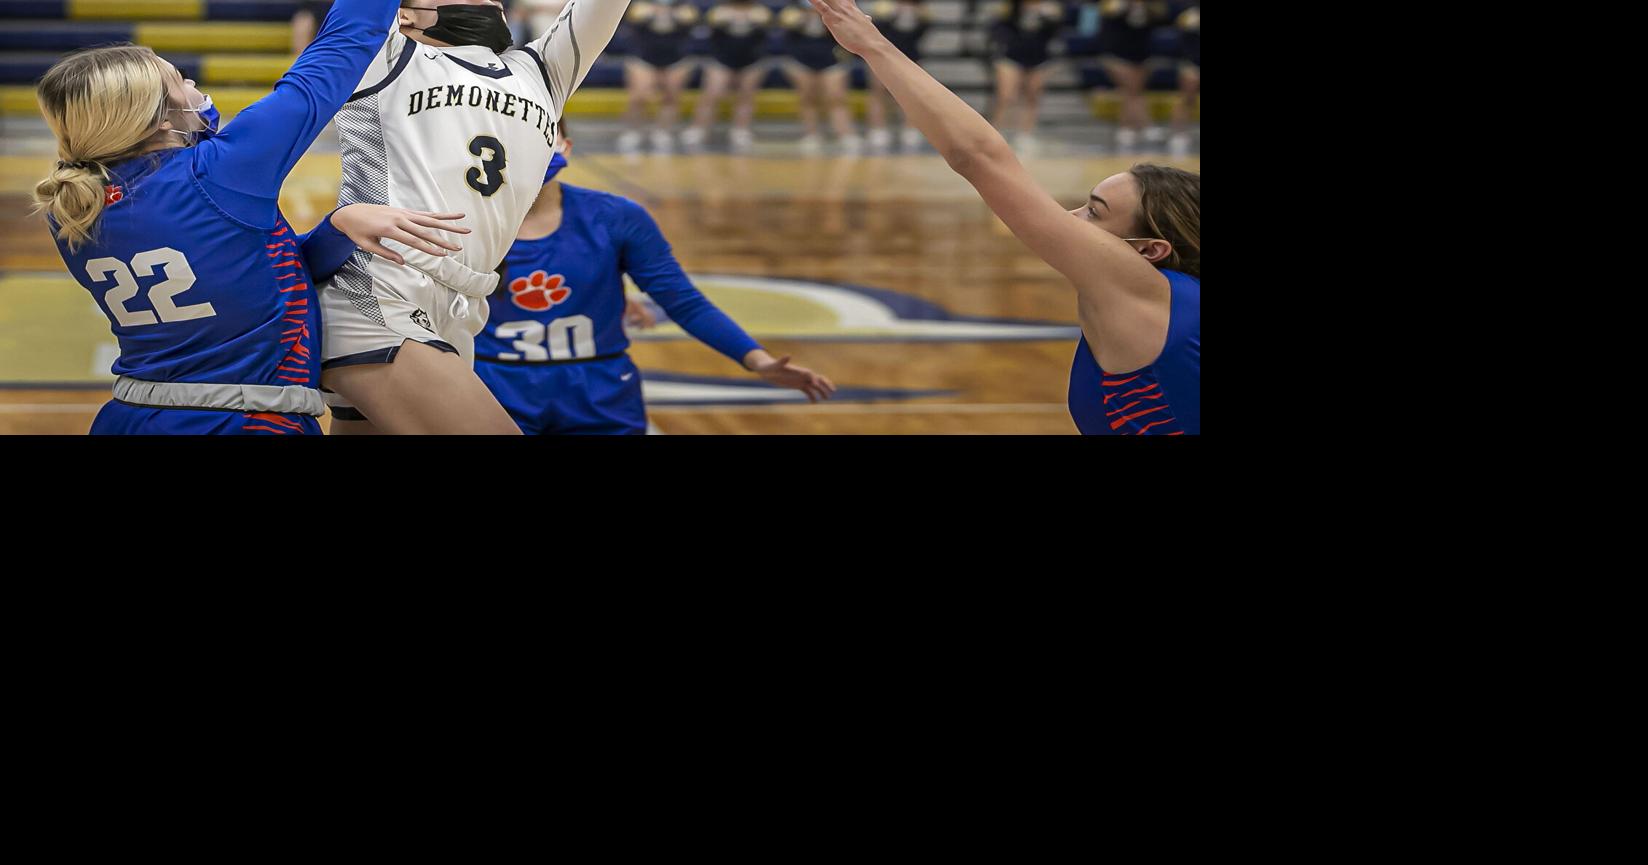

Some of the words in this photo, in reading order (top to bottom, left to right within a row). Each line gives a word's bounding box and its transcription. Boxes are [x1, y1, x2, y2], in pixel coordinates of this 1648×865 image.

[407, 84, 556, 148] DEMONETTES
[465, 134, 508, 197] 3
[85, 246, 217, 327] 22
[495, 314, 597, 361] 30
